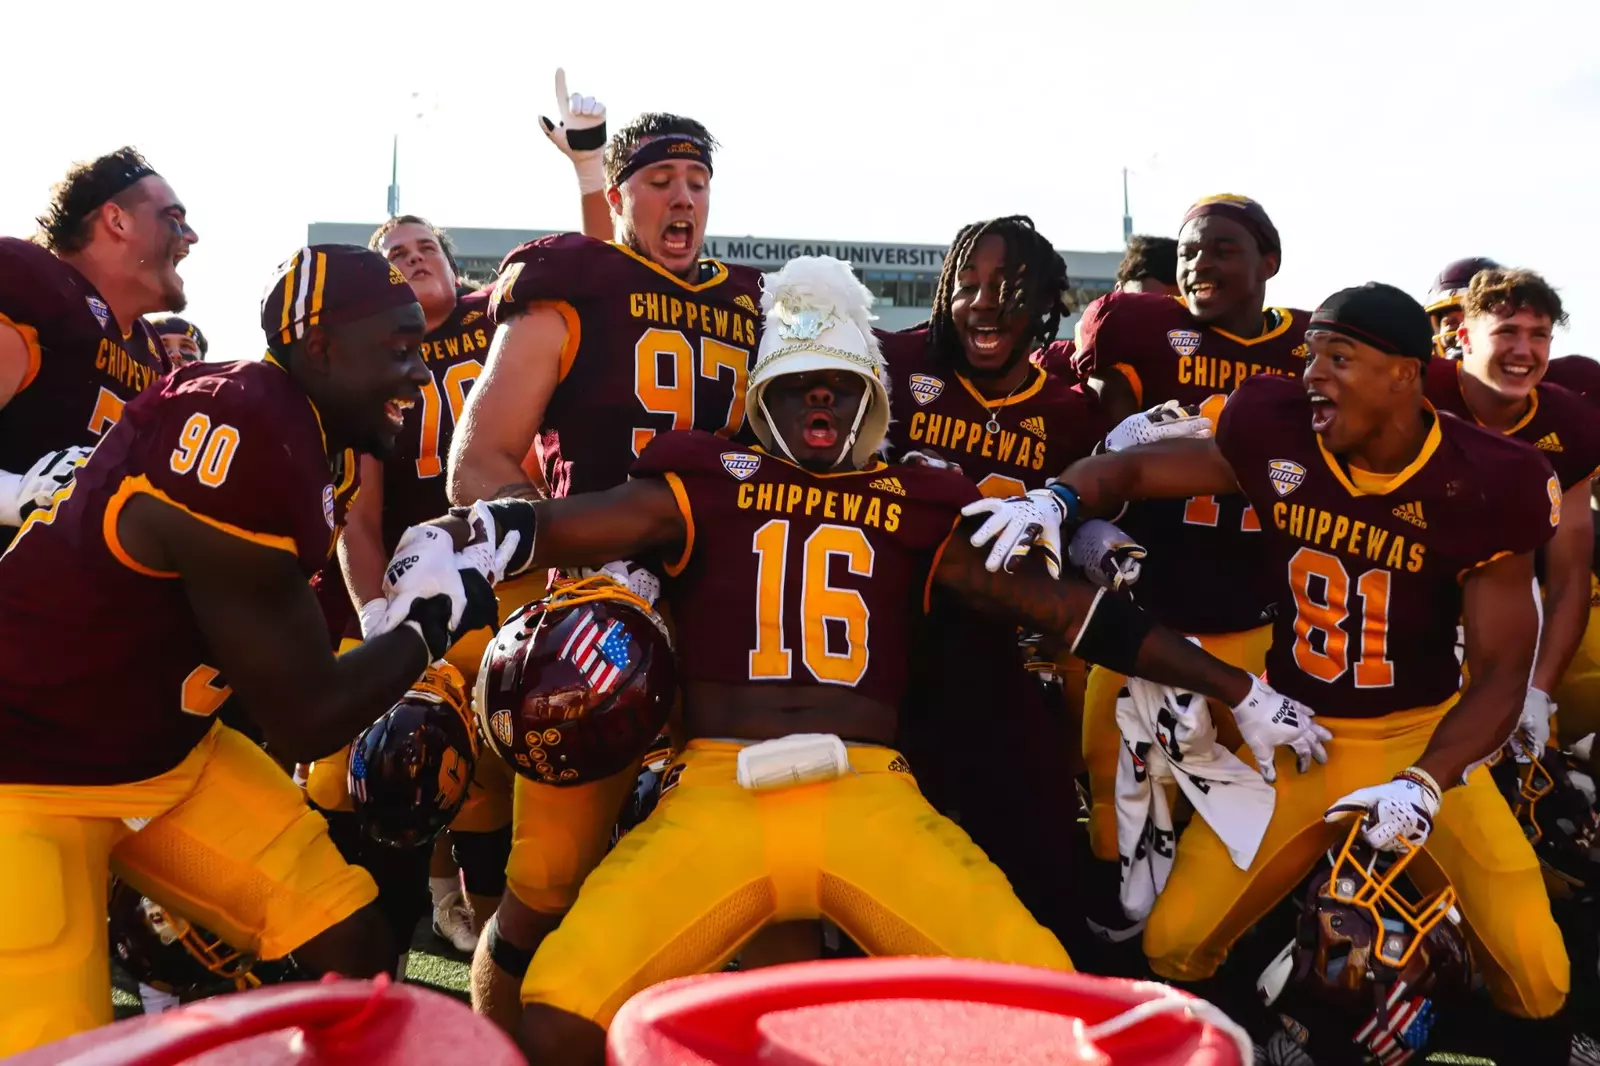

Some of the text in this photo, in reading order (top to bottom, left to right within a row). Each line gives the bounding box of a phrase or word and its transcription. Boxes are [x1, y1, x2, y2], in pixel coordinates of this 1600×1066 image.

[727, 241, 831, 260] MICHIGAN
[420, 328, 488, 362] PEWAS
[630, 292, 755, 346] CHIPPEWAS
[95, 337, 163, 393] CHIPPEW
[1177, 355, 1297, 390] CHIPP
[631, 327, 751, 459] 97
[170, 412, 241, 489] 90
[908, 411, 1047, 472] CHIPPEWAS
[1019, 420, 1048, 441] adidas
[736, 482, 903, 534] CHIPPEWAS
[868, 481, 907, 497] adidas
[1273, 502, 1427, 573] CHIPPEWAS
[1391, 507, 1428, 530] adidas
[748, 519, 876, 688] 16
[1287, 546, 1396, 689] 81
